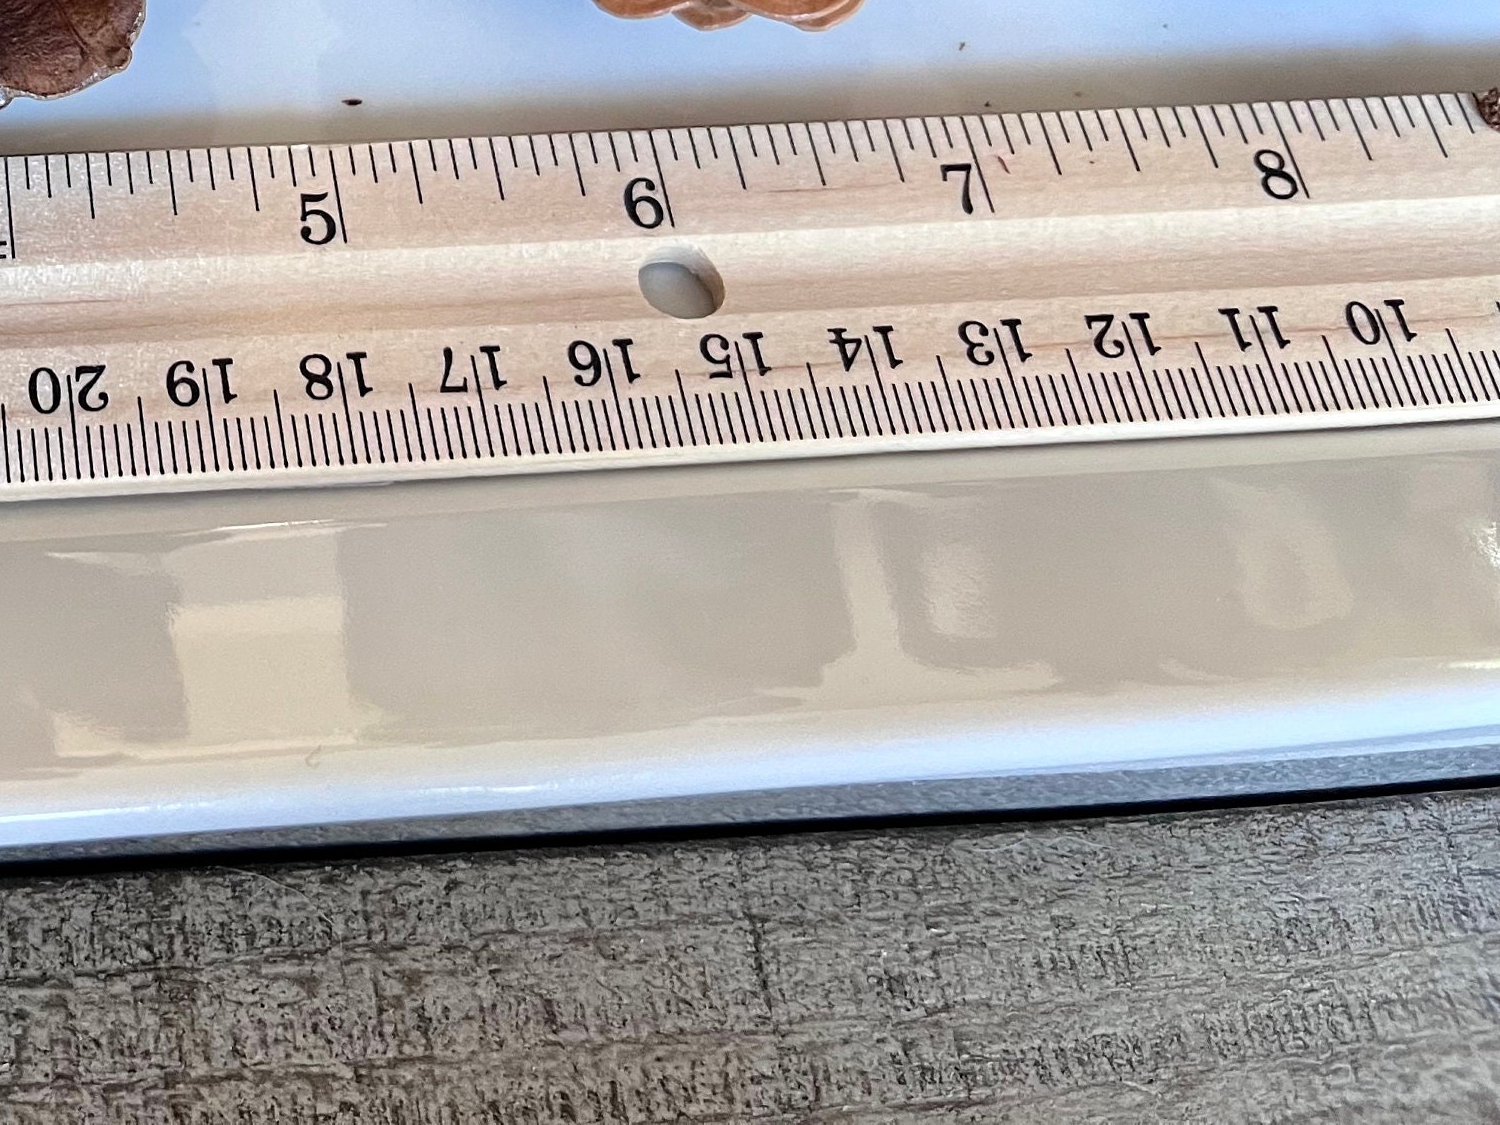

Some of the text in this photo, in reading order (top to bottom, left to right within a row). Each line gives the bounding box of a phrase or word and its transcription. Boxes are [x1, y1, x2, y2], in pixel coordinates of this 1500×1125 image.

[300, 192, 336, 244] 5
[623, 178, 665, 229] 6
[942, 164, 974, 213] 7
[1254, 149, 1299, 200] 8
[957, 318, 1033, 367] 13
[1085, 312, 1162, 359] 12
[1218, 305, 1292, 352] 11
[1345, 298, 1419, 345] 10
[440, 345, 508, 394] 17
[567, 338, 643, 387] 16
[700, 331, 773, 379] 15
[827, 325, 904, 372] 14
[27, 365, 110, 415] 20
[166, 357, 238, 407] 19
[300, 351, 374, 401] 18
